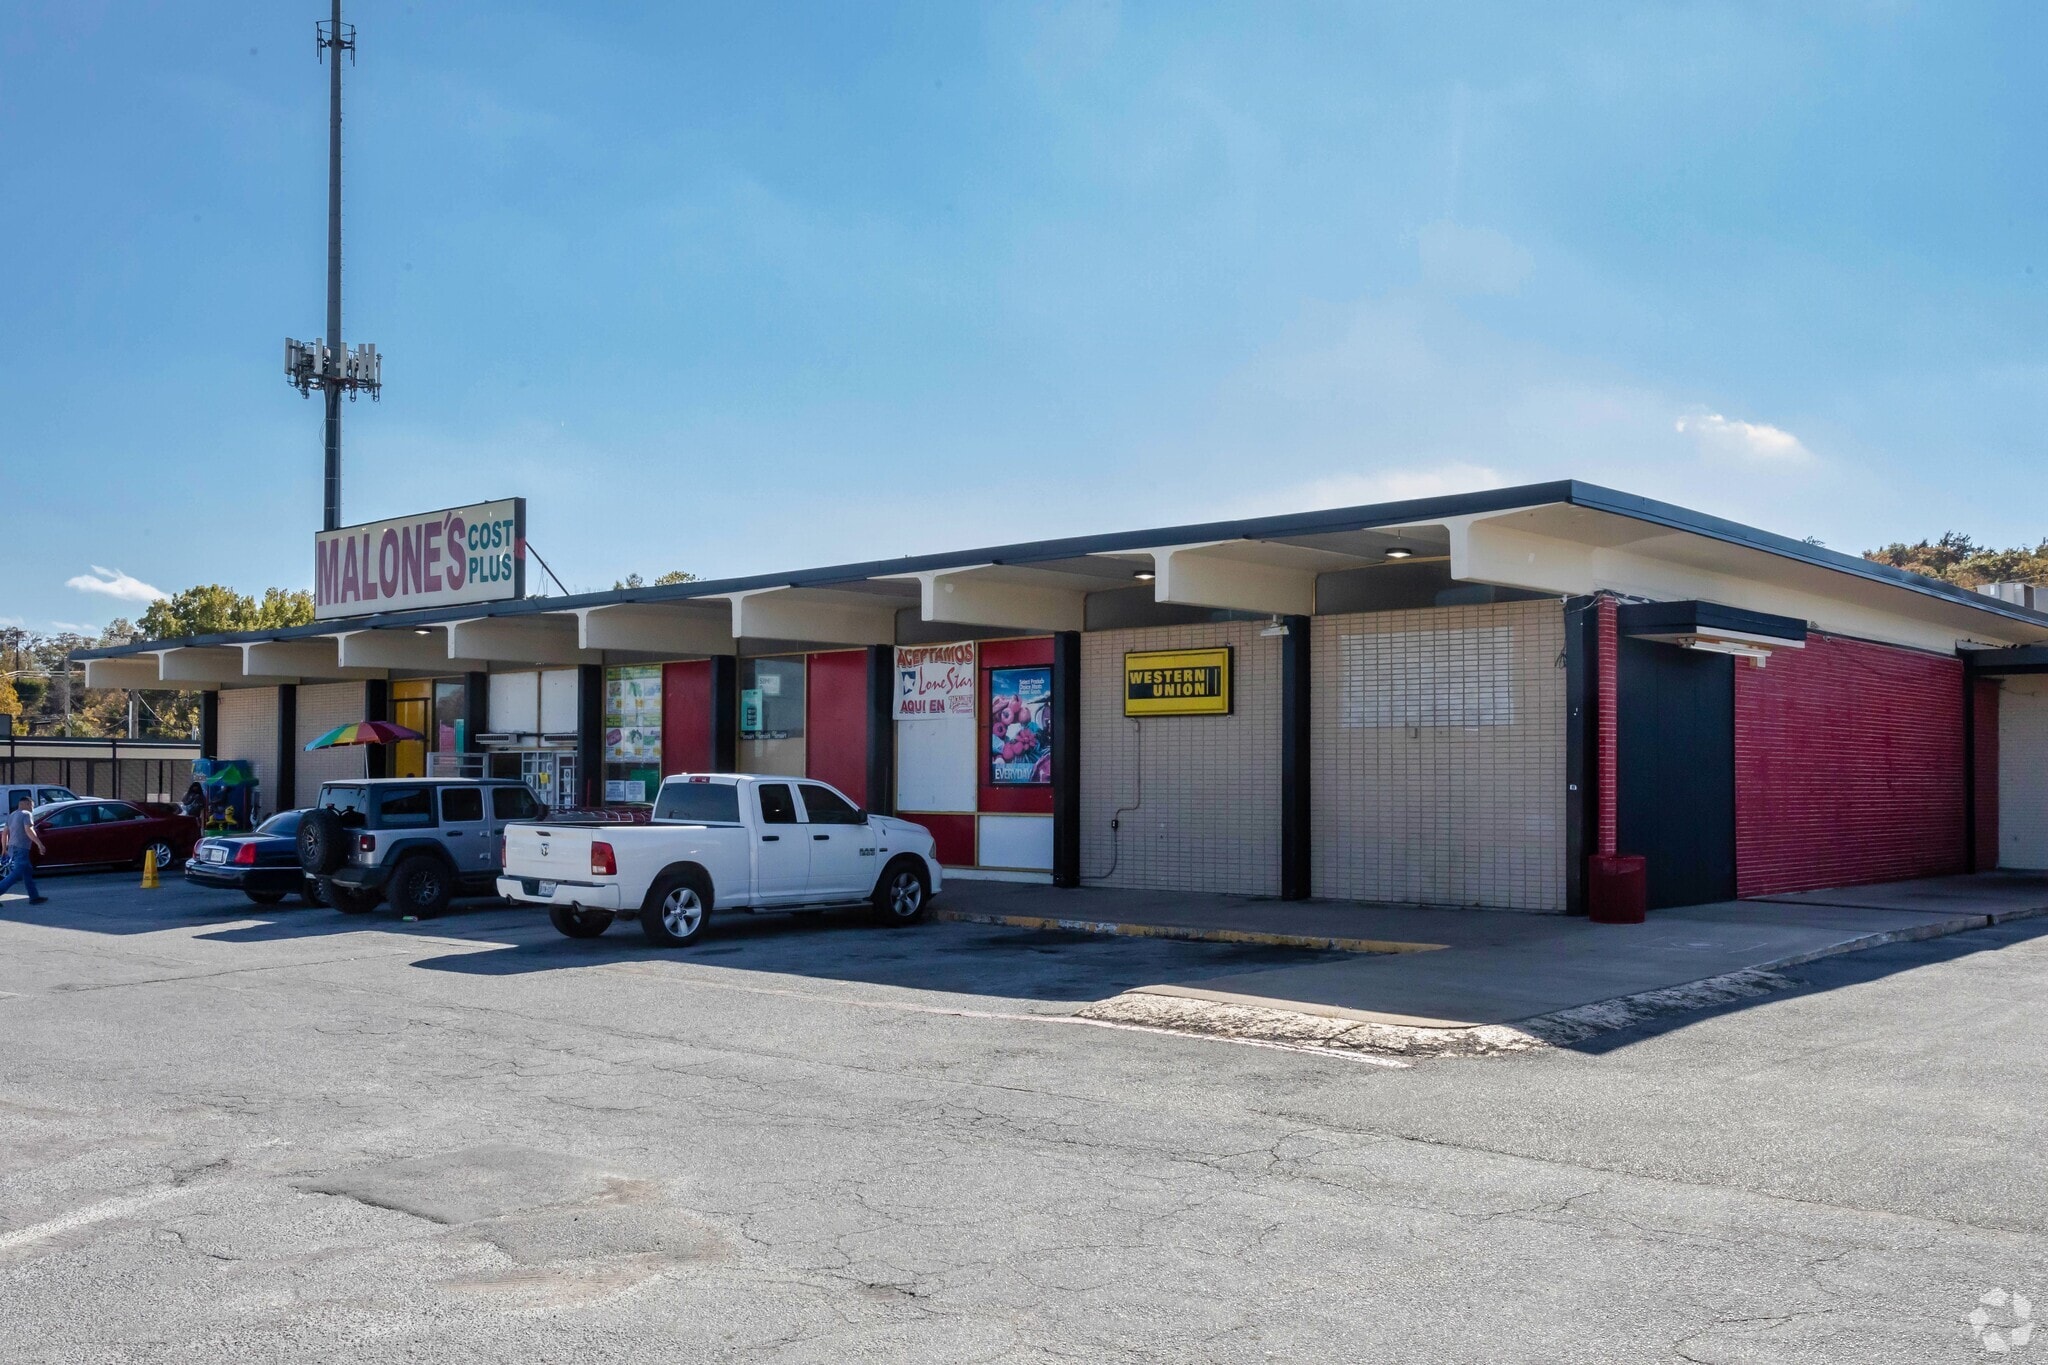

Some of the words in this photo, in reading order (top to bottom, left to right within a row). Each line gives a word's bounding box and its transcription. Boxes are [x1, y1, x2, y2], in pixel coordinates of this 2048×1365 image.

[468, 519, 514, 551] COST
[317, 511, 466, 607] MALONE'S
[469, 553, 512, 584] PLUS
[897, 643, 974, 669] ACEPTAMOS
[919, 666, 946, 695] Lone
[946, 667, 974, 695] Star
[1129, 668, 1205, 684] WESTERN
[1153, 682, 1205, 697] UNION
[900, 699, 926, 714] AQUI
[929, 699, 946, 714] EN
[995, 768, 1032, 780] EVERYDAY
